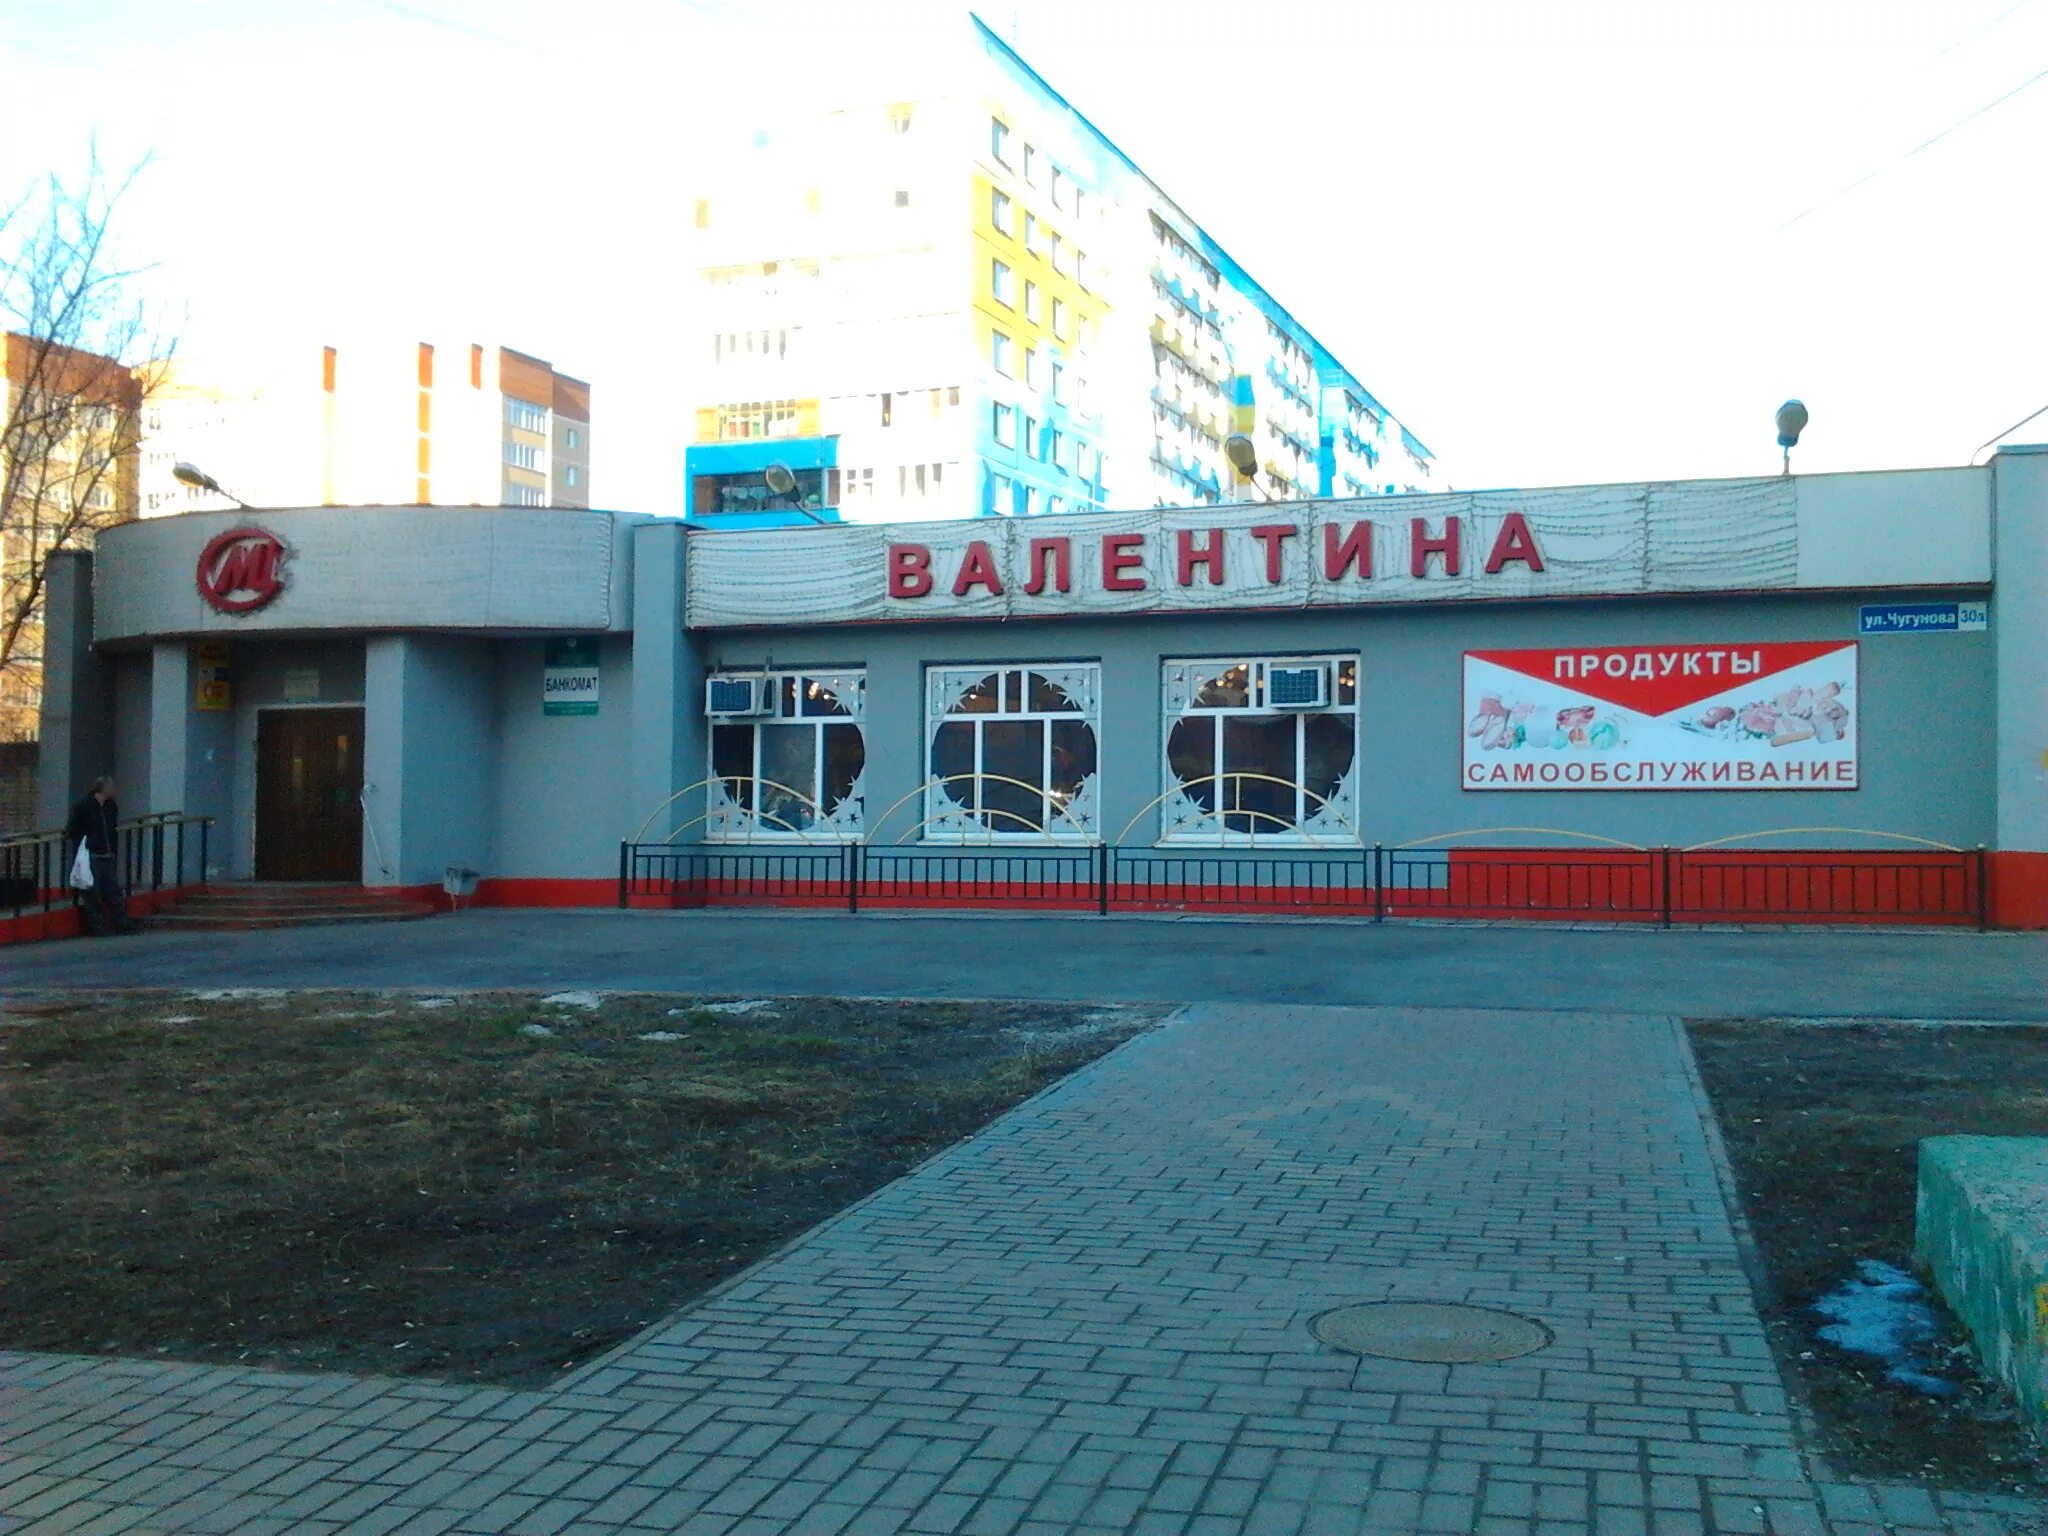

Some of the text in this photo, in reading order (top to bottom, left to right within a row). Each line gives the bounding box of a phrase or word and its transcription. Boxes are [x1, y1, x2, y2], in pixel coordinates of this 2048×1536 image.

[887, 512, 1545, 598] ВАЛЕНТИНА
[1554, 650, 1761, 680] ПРОДУКТЫ
[546, 676, 598, 692] БАНКОМАТ
[1467, 760, 1854, 783] САМООБСЛУЖИВАНИЕ
